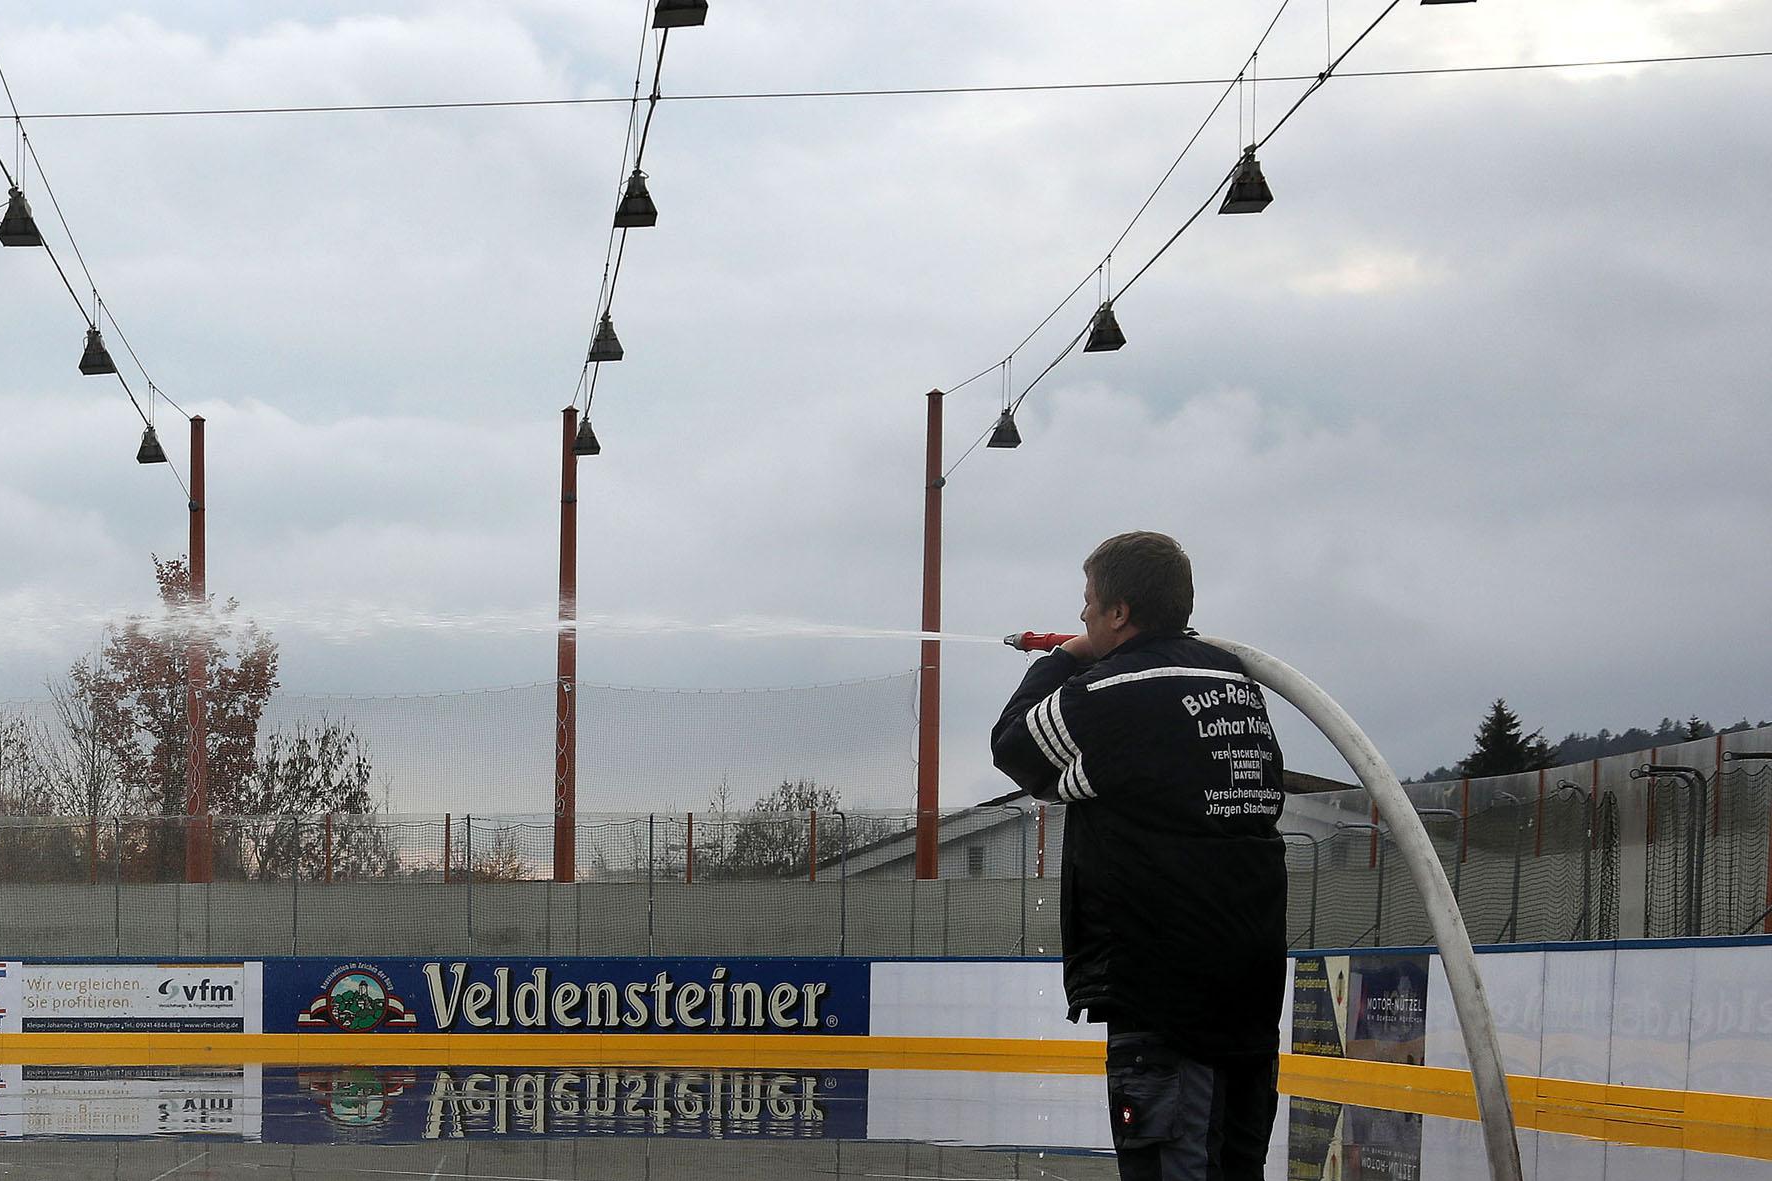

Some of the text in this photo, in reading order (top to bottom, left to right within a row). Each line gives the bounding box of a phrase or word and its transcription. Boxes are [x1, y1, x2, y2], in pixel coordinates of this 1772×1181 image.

[1198, 717, 1245, 738] Lothar
[1233, 760, 1260, 769] KAMMER
[1234, 771, 1260, 780] BAYERN
[1204, 787, 1281, 802] Versicherungsbüro
[1205, 803, 1241, 818] Jürgen
[27, 978, 144, 994] Wir vergleichen.
[182, 979, 234, 1001] vfm
[27, 995, 133, 1011] Sie profitieren.
[422, 962, 826, 1029] Veldensteiner
[1367, 994, 1423, 1012] MOTOR-NÜTZEL
